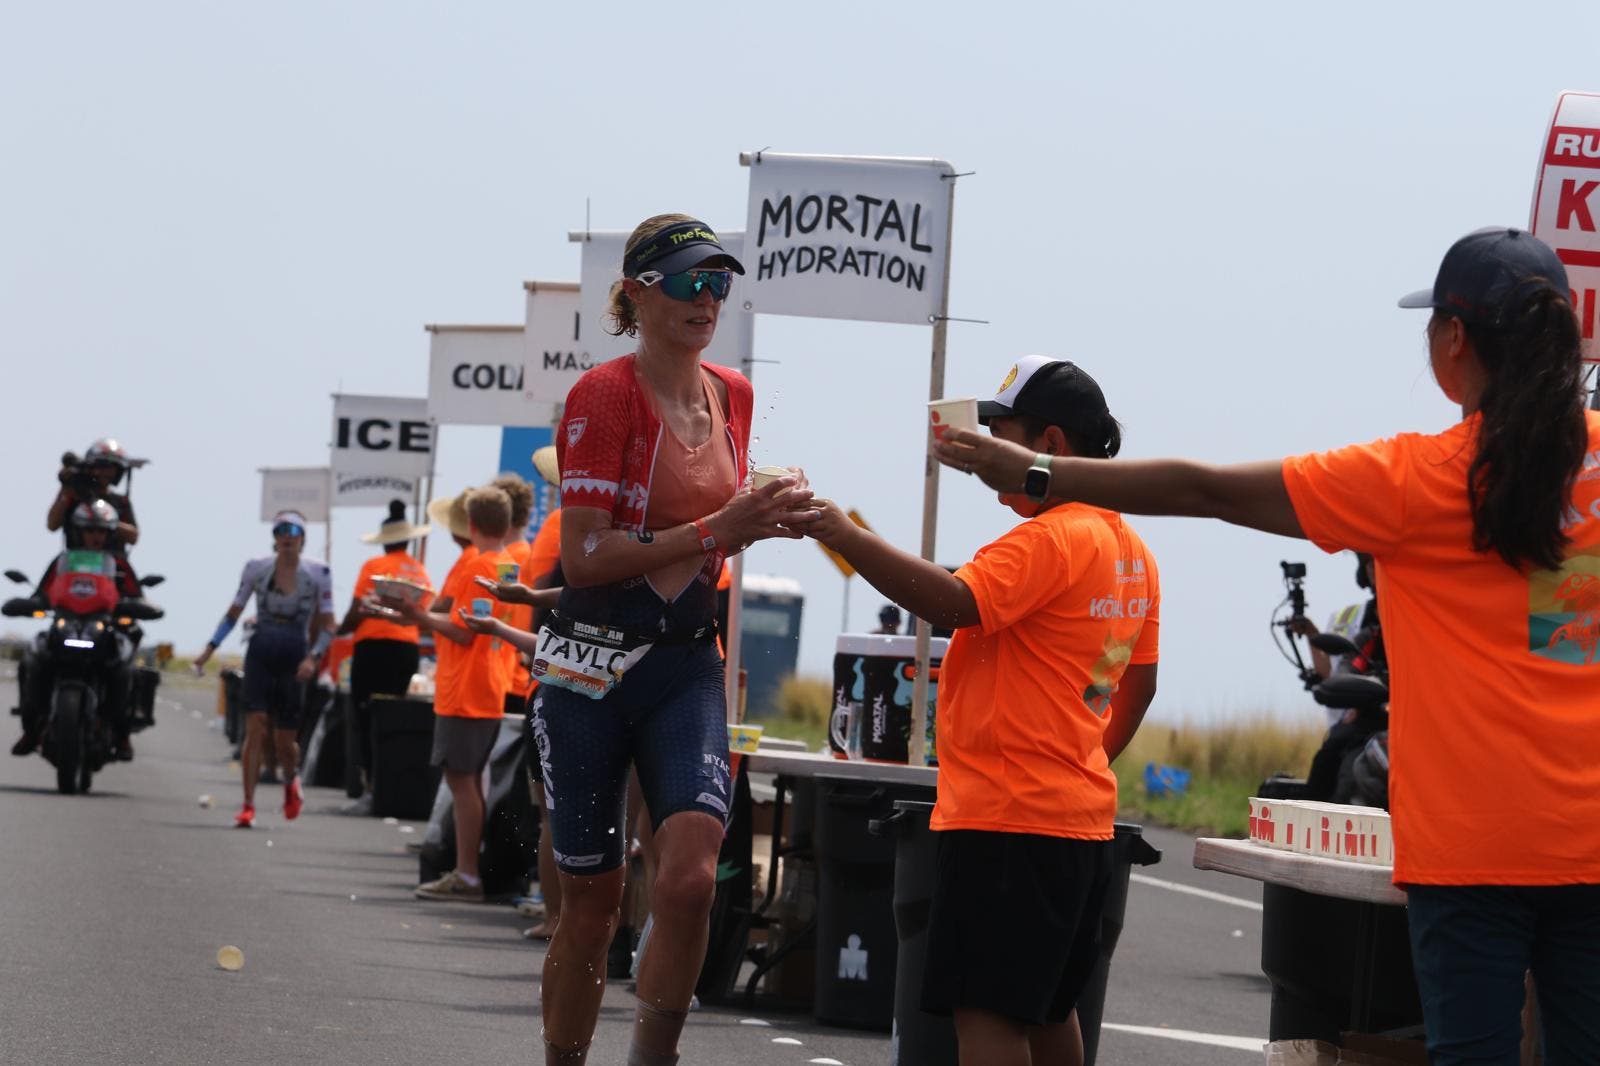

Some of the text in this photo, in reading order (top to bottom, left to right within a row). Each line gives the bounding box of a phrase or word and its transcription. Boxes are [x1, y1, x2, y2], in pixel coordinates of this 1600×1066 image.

[757, 194, 933, 254] MORTAL
[1556, 178, 1600, 233] K
[757, 246, 926, 292] HYDRATION
[336, 417, 431, 453] ICE
[872, 693, 884, 744] MORTAL
